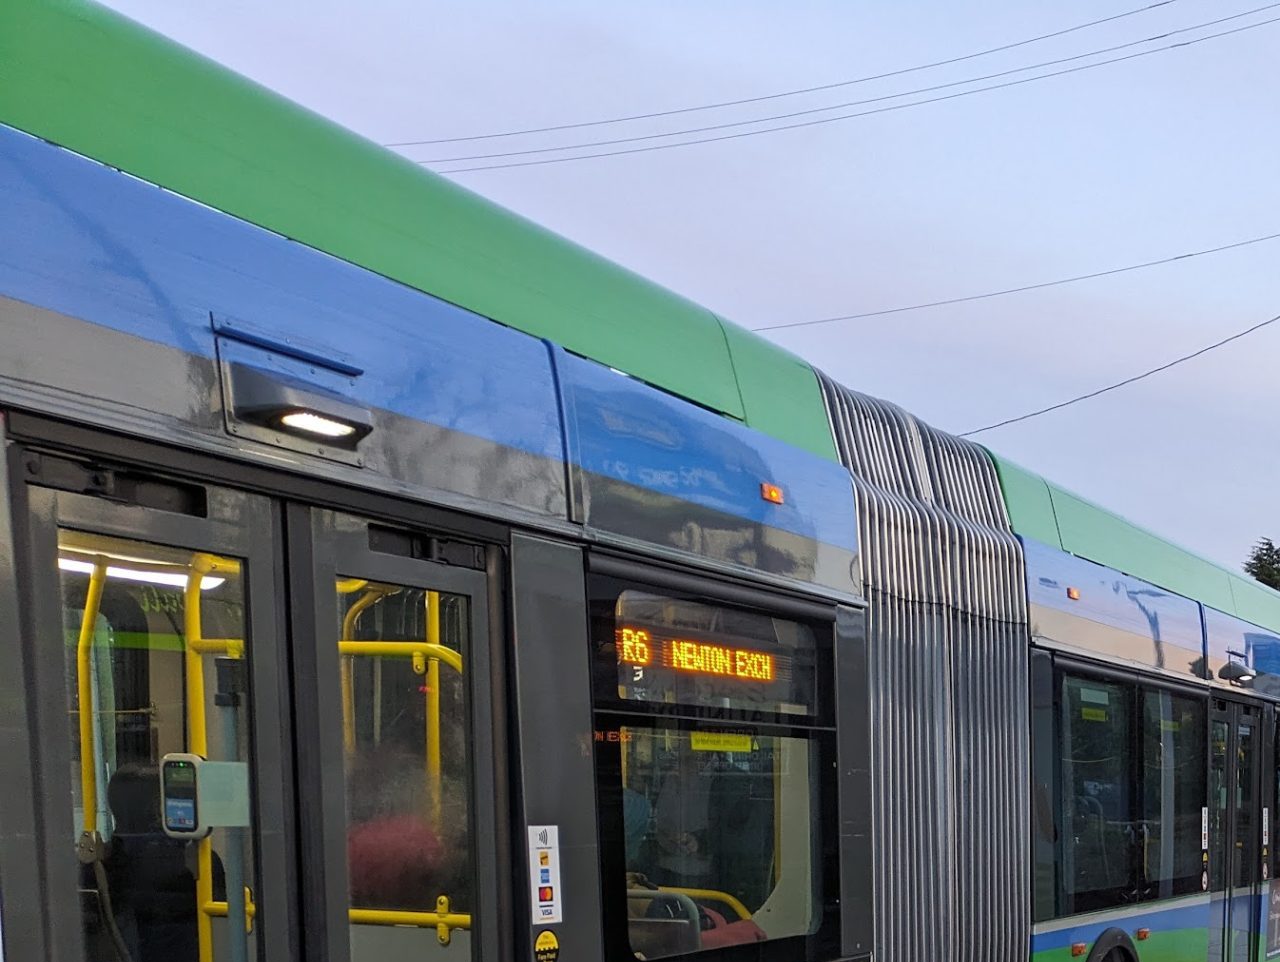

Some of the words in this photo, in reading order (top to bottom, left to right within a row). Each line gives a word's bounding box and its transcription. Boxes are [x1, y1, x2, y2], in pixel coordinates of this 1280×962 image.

[622, 628, 649, 663] R6
[671, 640, 731, 675] NEWTON
[735, 651, 772, 680] EXCH
